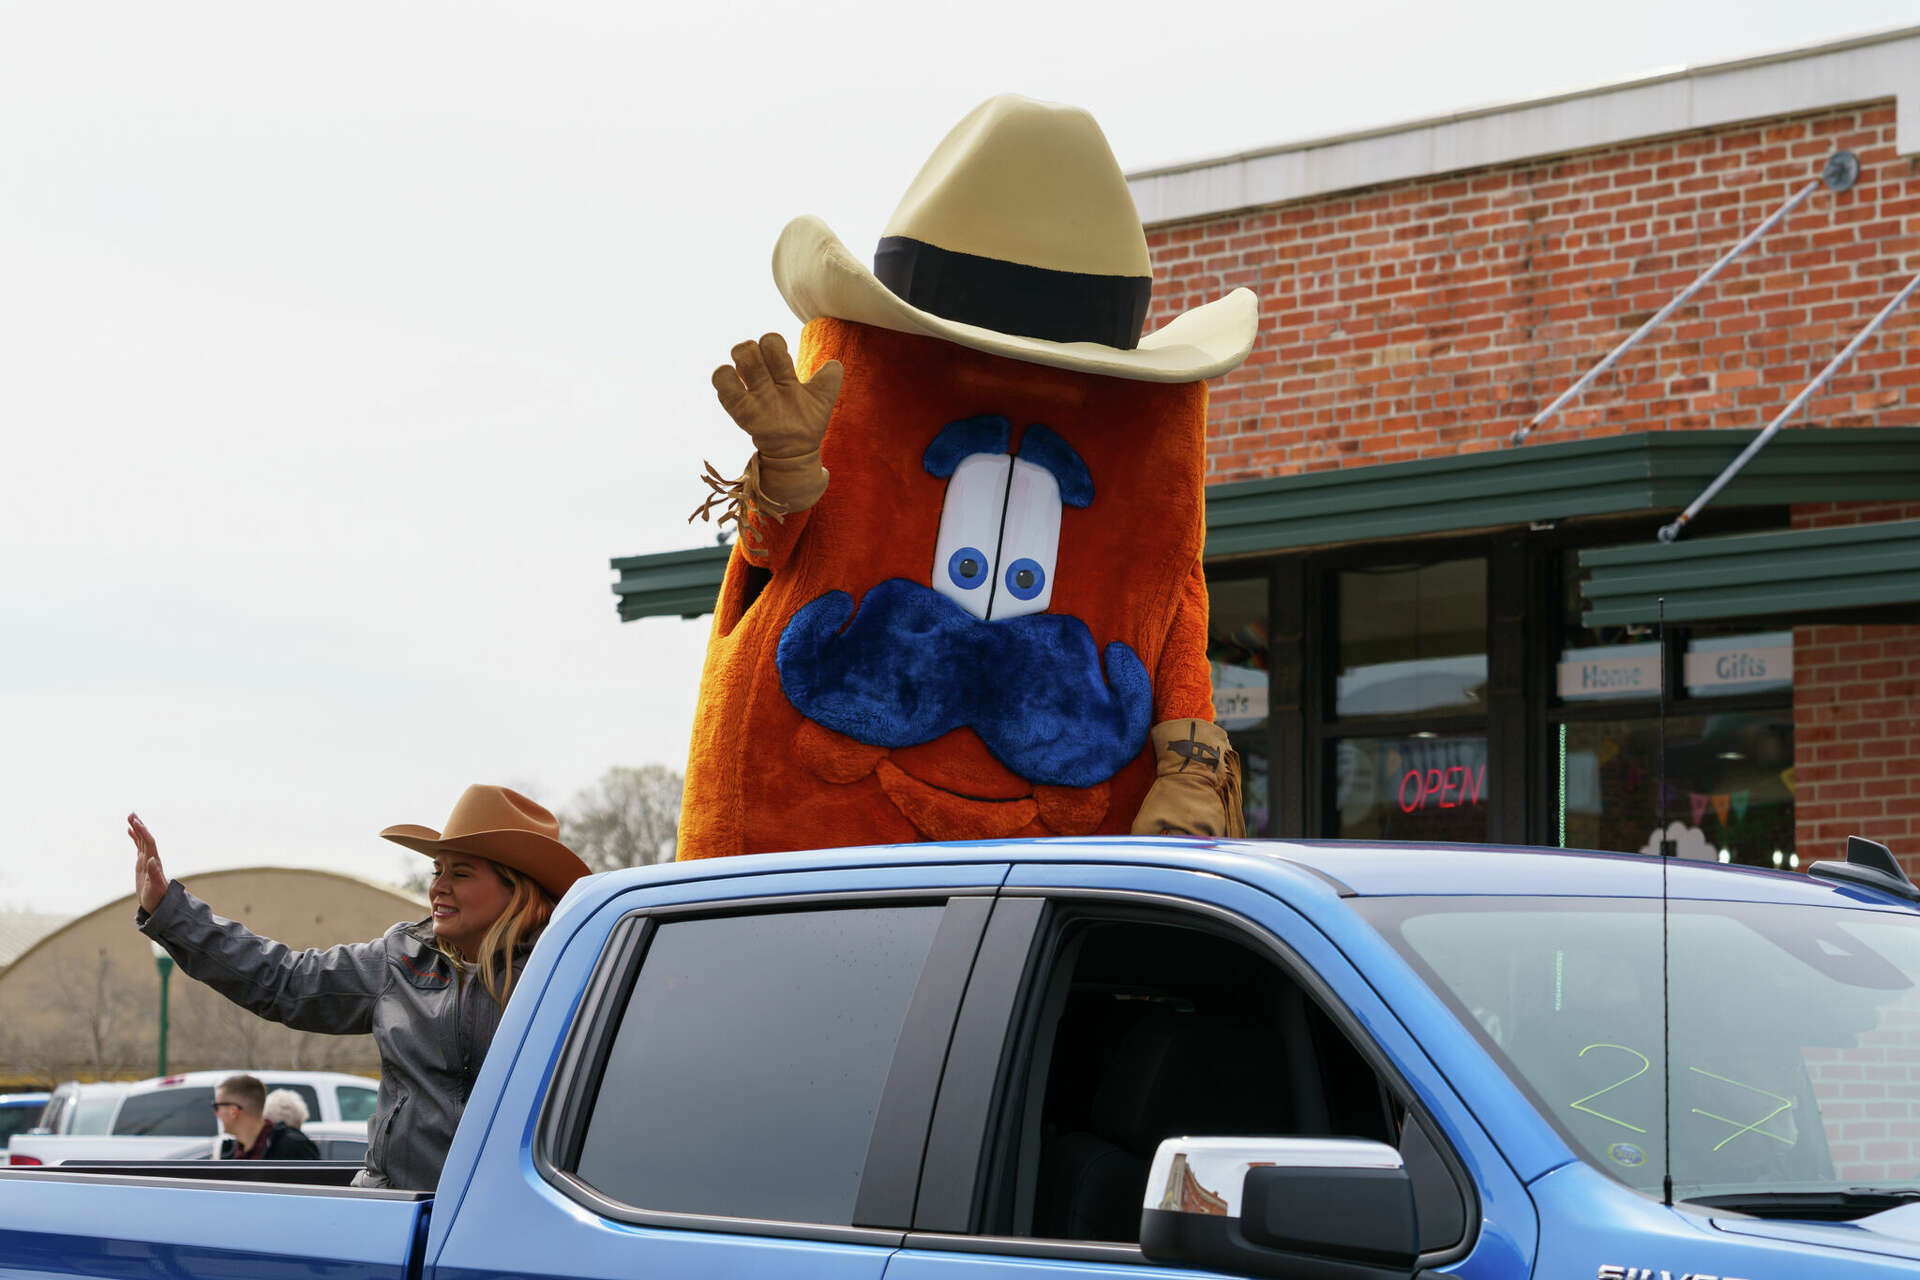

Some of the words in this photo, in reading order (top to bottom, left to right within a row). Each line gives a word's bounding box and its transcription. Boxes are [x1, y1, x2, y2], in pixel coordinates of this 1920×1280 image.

[1581, 664, 1642, 689] Home
[1715, 653, 1767, 680] Gifts
[1398, 764, 1486, 814] OPEN
[1597, 1264, 1754, 1280] SILV
